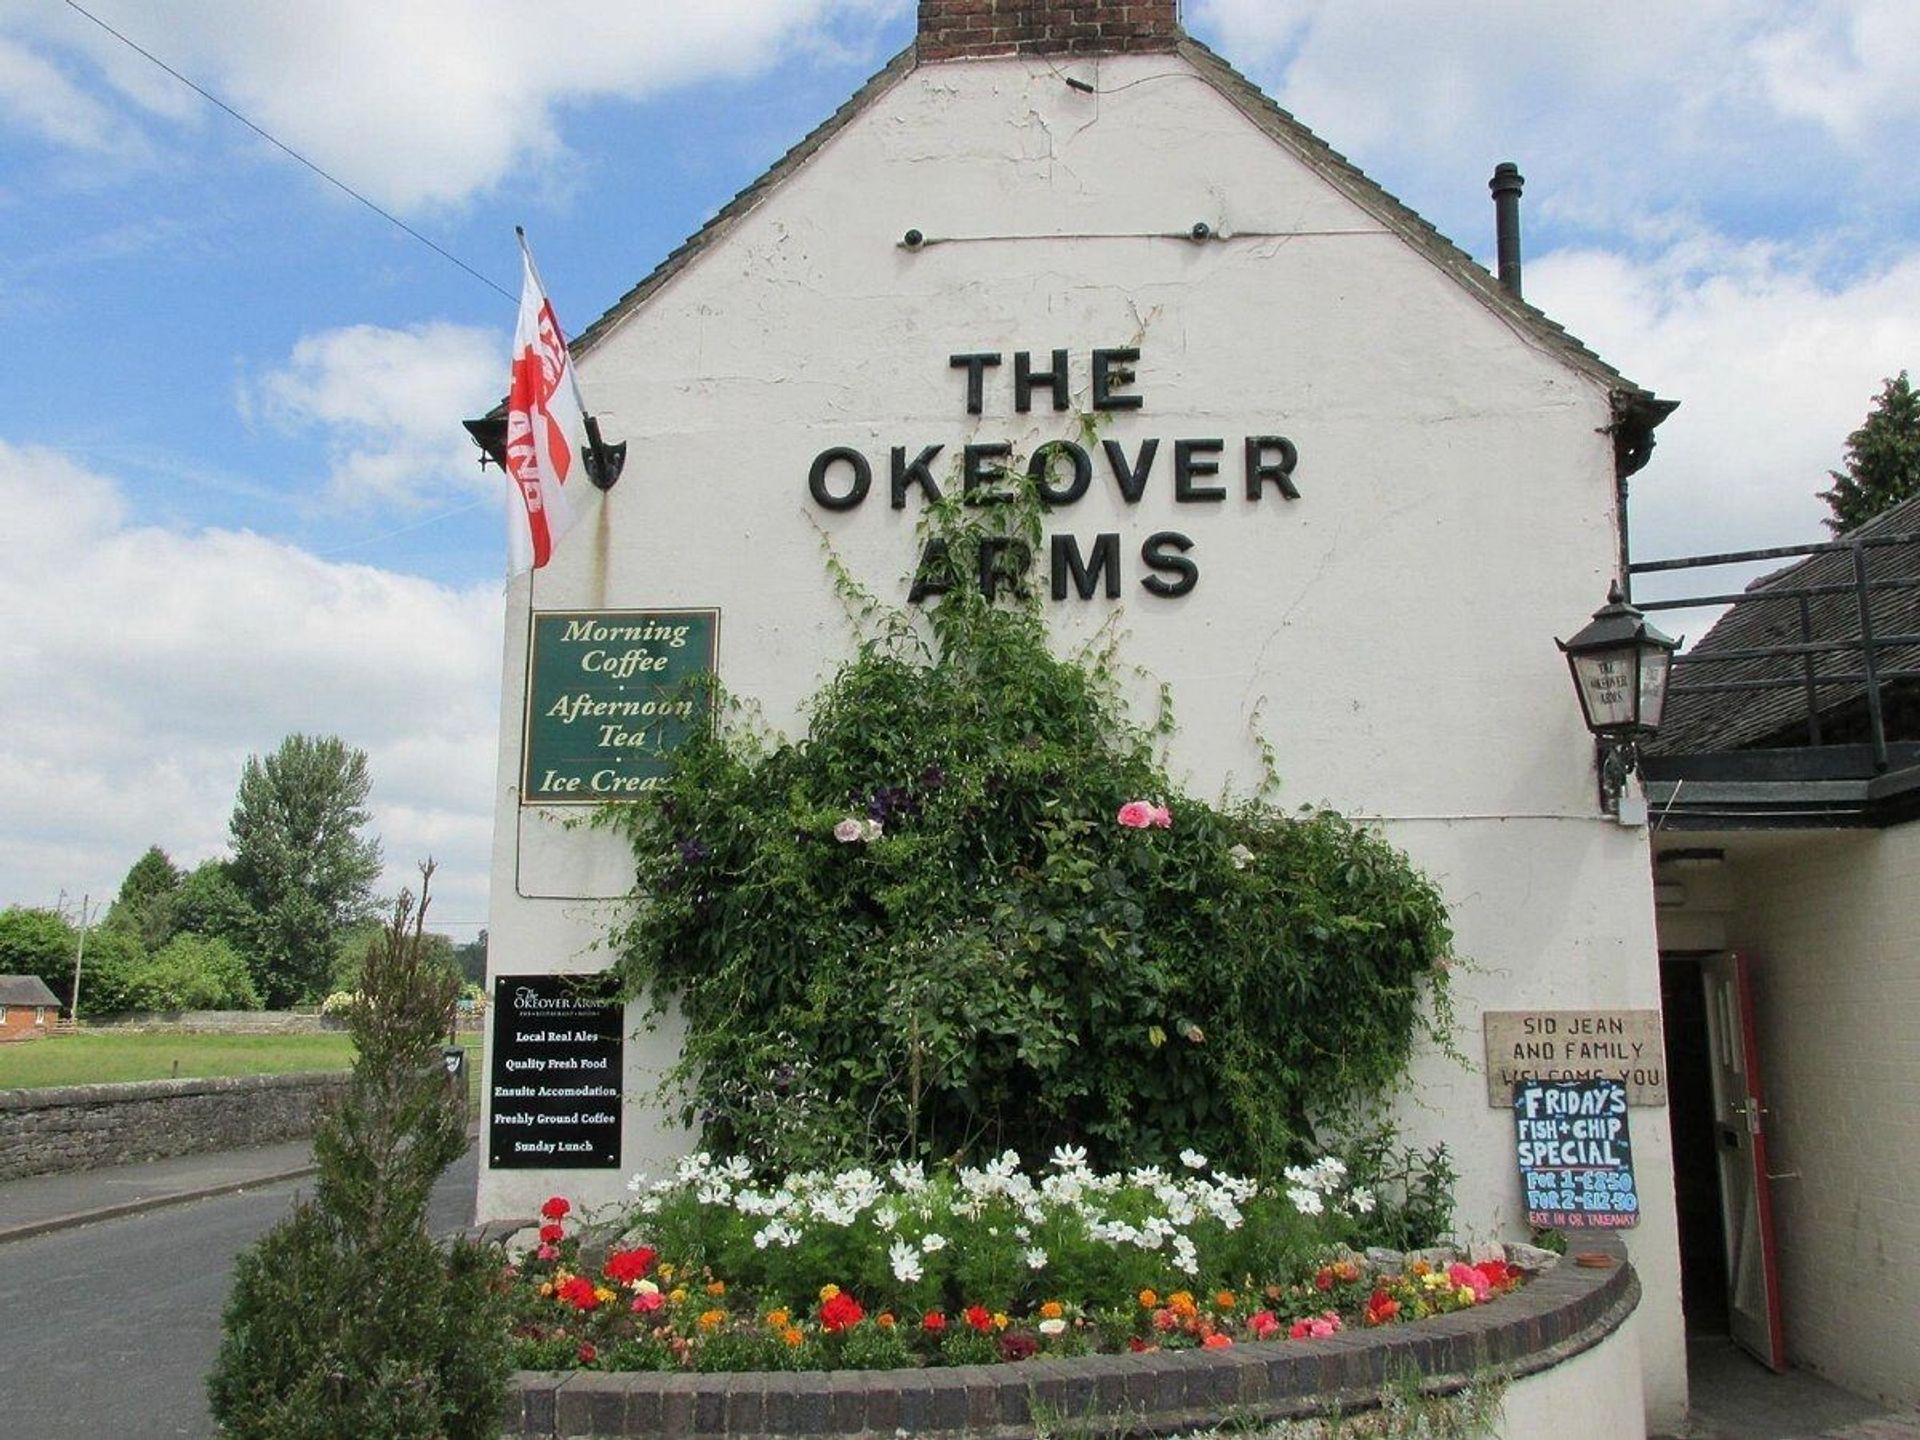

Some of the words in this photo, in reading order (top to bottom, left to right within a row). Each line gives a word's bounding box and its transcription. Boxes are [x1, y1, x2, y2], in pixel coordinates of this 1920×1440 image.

[949, 347, 1144, 414] THE
[808, 435, 1302, 511] OKEOVER
[907, 531, 1200, 604] ARMS
[561, 620, 690, 648] Morning
[582, 649, 668, 678] Coffee
[546, 693, 693, 724] Afternoon
[598, 725, 646, 747] Tea
[539, 770, 581, 792] Ice
[1524, 1018, 1557, 1034] SID
[1568, 1018, 1624, 1034] JEAN
[516, 1031, 546, 1042] Local
[549, 1031, 572, 1042] Real
[575, 1031, 598, 1042] Ales
[1513, 1042, 1554, 1060] AND
[1566, 1042, 1643, 1060] FAMILY
[505, 1058, 546, 1071] Quality
[548, 1058, 578, 1069] Fresh
[580, 1058, 607, 1069] Food
[1619, 1069, 1659, 1086] YOU
[494, 1086, 535, 1097] Ensuite
[537, 1085, 617, 1097] Accomodation
[494, 1113, 534, 1126] Freshly
[537, 1112, 578, 1124] Ground
[581, 1112, 615, 1124] Coffee
[515, 1141, 556, 1154] Sunday
[558, 1140, 593, 1152] Lunch
[1519, 1140, 1621, 1166] SPECIAL
[1527, 1172, 1556, 1189] FOR
[1528, 1190, 1560, 1209] FOR
[1553, 1212, 1566, 1225] IN
